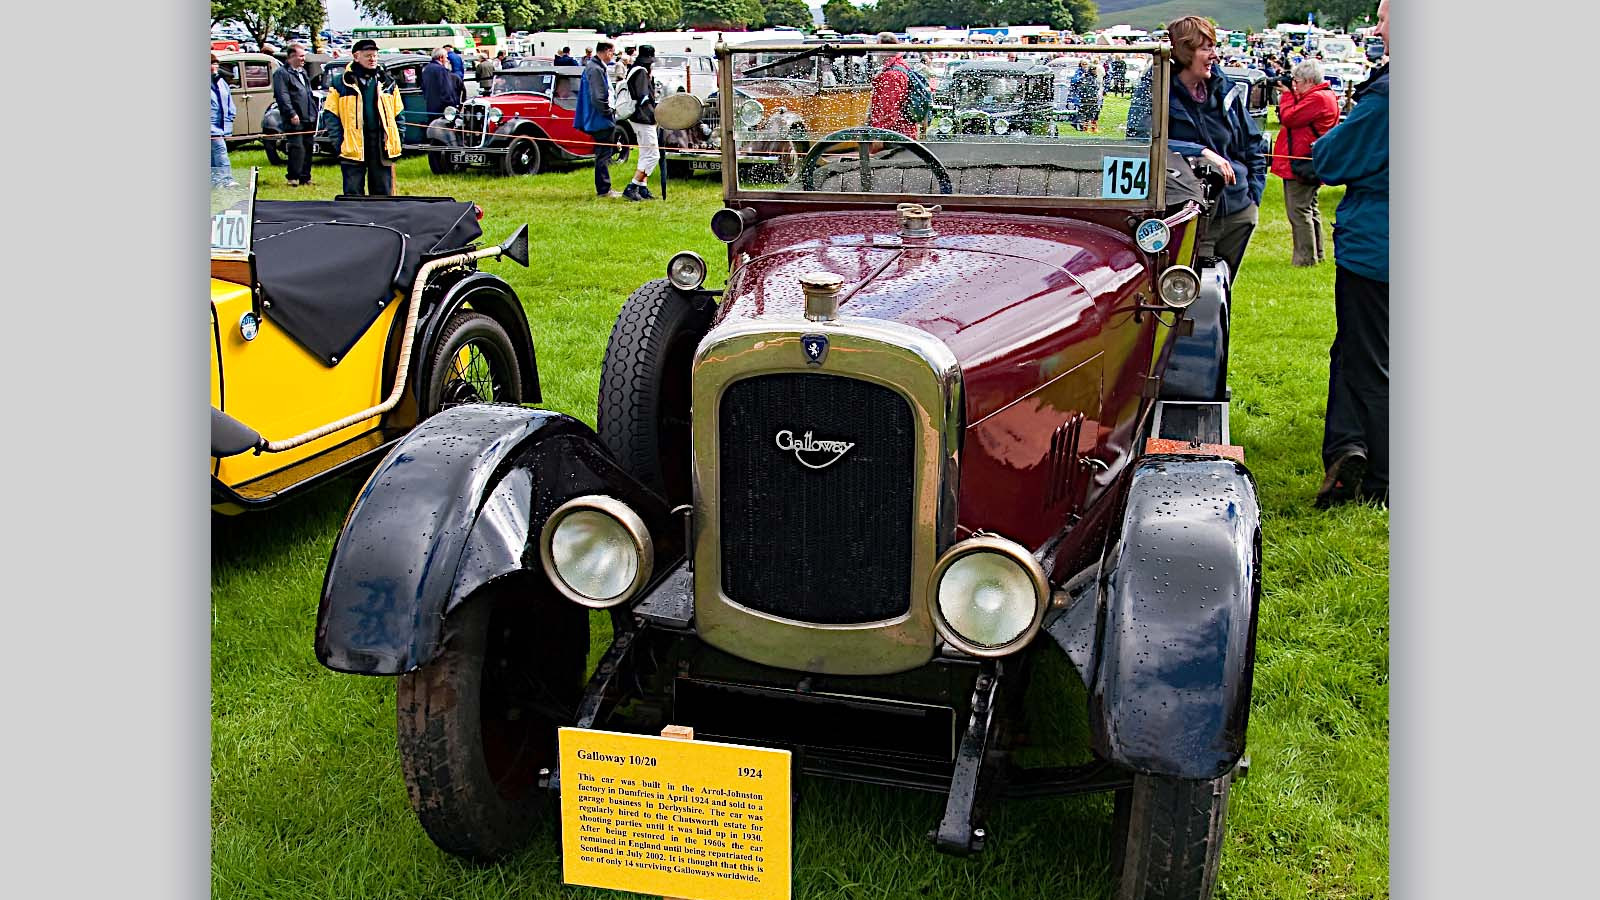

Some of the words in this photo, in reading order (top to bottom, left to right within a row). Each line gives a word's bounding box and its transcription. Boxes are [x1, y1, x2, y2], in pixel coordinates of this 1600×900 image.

[692, 160, 708, 170] BAK
[1107, 159, 1147, 196] 154
[216, 216, 246, 247] 170
[775, 429, 856, 469] Galloway
[577, 749, 626, 766] Galloway
[629, 755, 657, 767] 10/20
[737, 767, 763, 779] 1924
[577, 773, 595, 782] This
[642, 780, 661, 789] built
[667, 782, 675, 791] in
[682, 784, 695, 793] the
[701, 787, 763, 801] Arrol-Johnston
[578, 783, 606, 795] factory
[608, 786, 616, 794] in
[618, 787, 655, 799] Dumfries
[656, 792, 665, 800] in
[667, 794, 688, 803] April
[691, 796, 709, 805] 1924
[711, 799, 727, 807] and
[729, 801, 746, 809] sold
[578, 795, 605, 804] garage
[609, 797, 642, 807] business
[646, 801, 654, 809] in
[658, 802, 705, 815] Derbyshire.
[711, 808, 726, 817] The
[747, 814, 764, 822] was
[579, 805, 614, 816] regularly
[618, 808, 639, 817] hired
[655, 812, 668, 821] the
[672, 814, 719, 827] Chatsworth
[723, 822, 747, 830] estate
[751, 823, 764, 832] for
[579, 814, 612, 825] shooting
[615, 819, 642, 828] parties
[646, 823, 665, 831] until
[668, 823, 674, 832] it
[696, 827, 712, 836] laid
[715, 831, 726, 839] up
[730, 831, 738, 839] in
[743, 832, 763, 842] 1930.
[580, 824, 601, 833] After
[605, 826, 627, 837] being
[632, 832, 665, 841] restored
[671, 834, 679, 842] in
[685, 836, 697, 845] the
[704, 838, 726, 848] 1960s
[731, 842, 744, 850] the
[580, 835, 616, 845] remained
[618, 838, 626, 846] in
[628, 839, 661, 851] England
[663, 845, 682, 853] until
[684, 846, 706, 857] being
[708, 851, 753, 861] repatriated
[755, 855, 764, 863] to
[580, 844, 614, 855] Scotland
[616, 848, 624, 856] in
[626, 849, 642, 860] July
[645, 851, 666, 861] 2002.
[669, 854, 676, 862] It
[678, 855, 685, 863] is
[687, 857, 718, 868] thought
[720, 861, 737, 870] that
[739, 863, 754, 872] this
[596, 856, 605, 864] of
[605, 858, 623, 867] only
[625, 859, 634, 867] 14
[635, 862, 672, 873] surviving
[673, 865, 715, 878] Galloways
[716, 872, 761, 883] worldwide.
